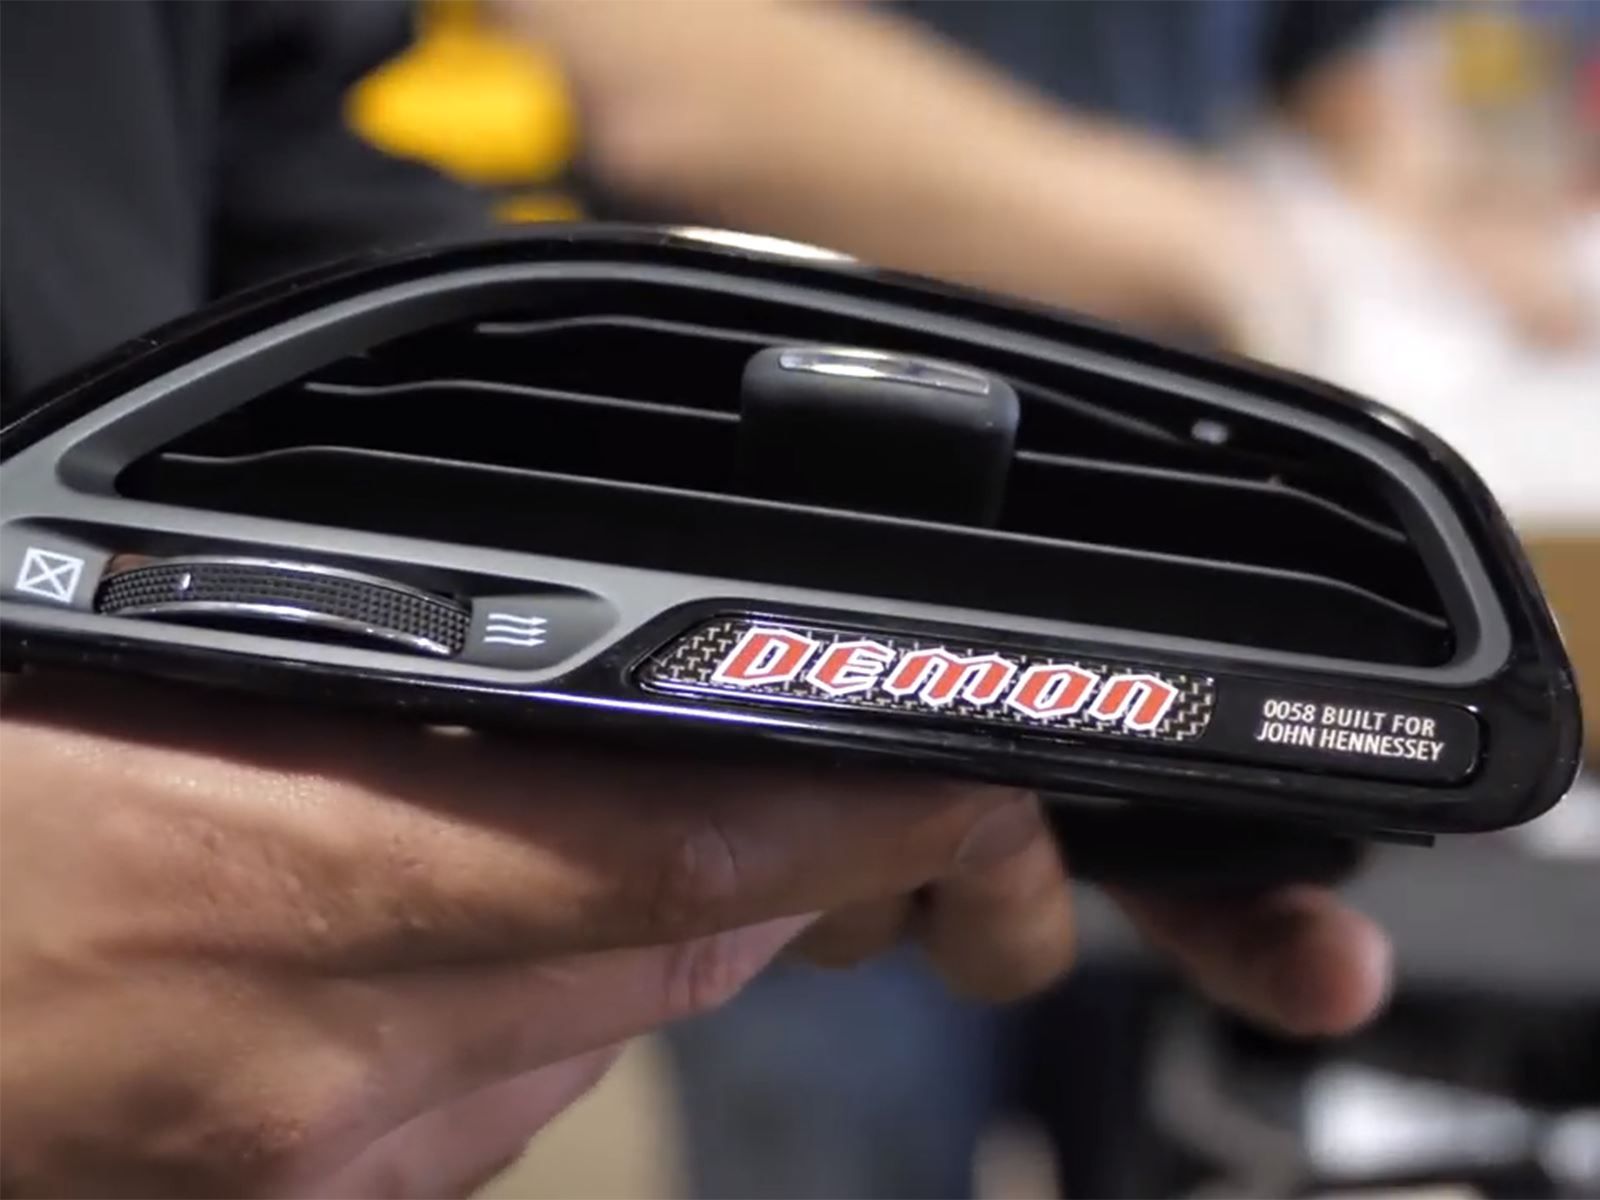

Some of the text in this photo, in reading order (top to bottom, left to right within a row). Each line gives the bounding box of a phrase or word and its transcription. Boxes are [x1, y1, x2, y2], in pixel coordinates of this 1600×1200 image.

[711, 626, 1178, 733] DEMON
[1263, 698, 1436, 738] 0058 BUILT FOR
[1256, 720, 1445, 762] JOHN HENNESSEY
